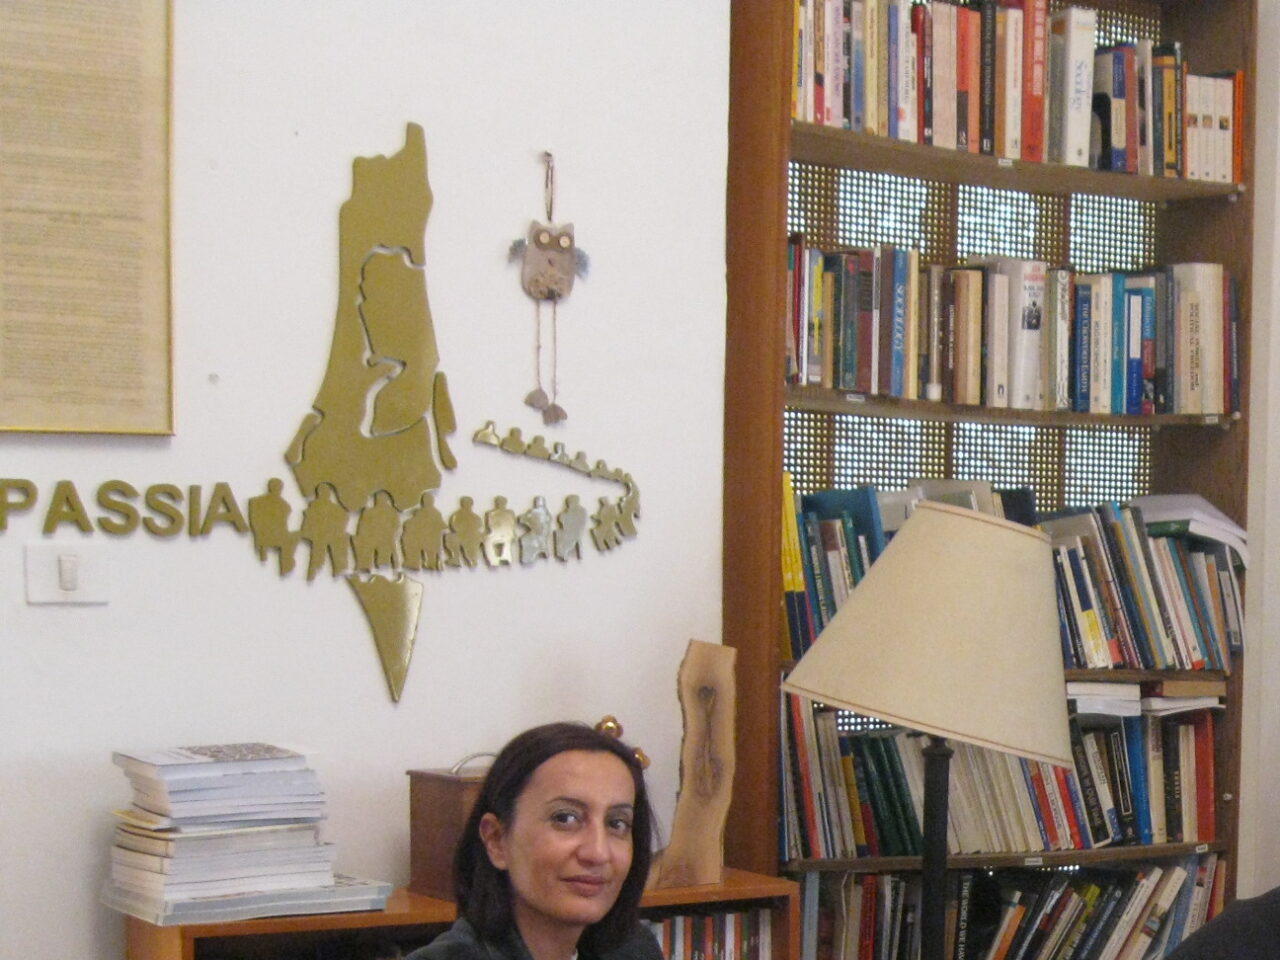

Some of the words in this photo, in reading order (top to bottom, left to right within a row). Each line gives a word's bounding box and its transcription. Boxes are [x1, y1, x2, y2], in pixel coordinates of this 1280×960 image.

[1071, 59, 1087, 113] Sociology
[894, 282, 905, 354] SOCIOLOGY
[1144, 296, 1153, 337] Ethnicity
[0, 478, 249, 537] PASSIA
[962, 881, 970, 898] THE
[959, 899, 969, 929] WORLD
[958, 930, 967, 943] WE
